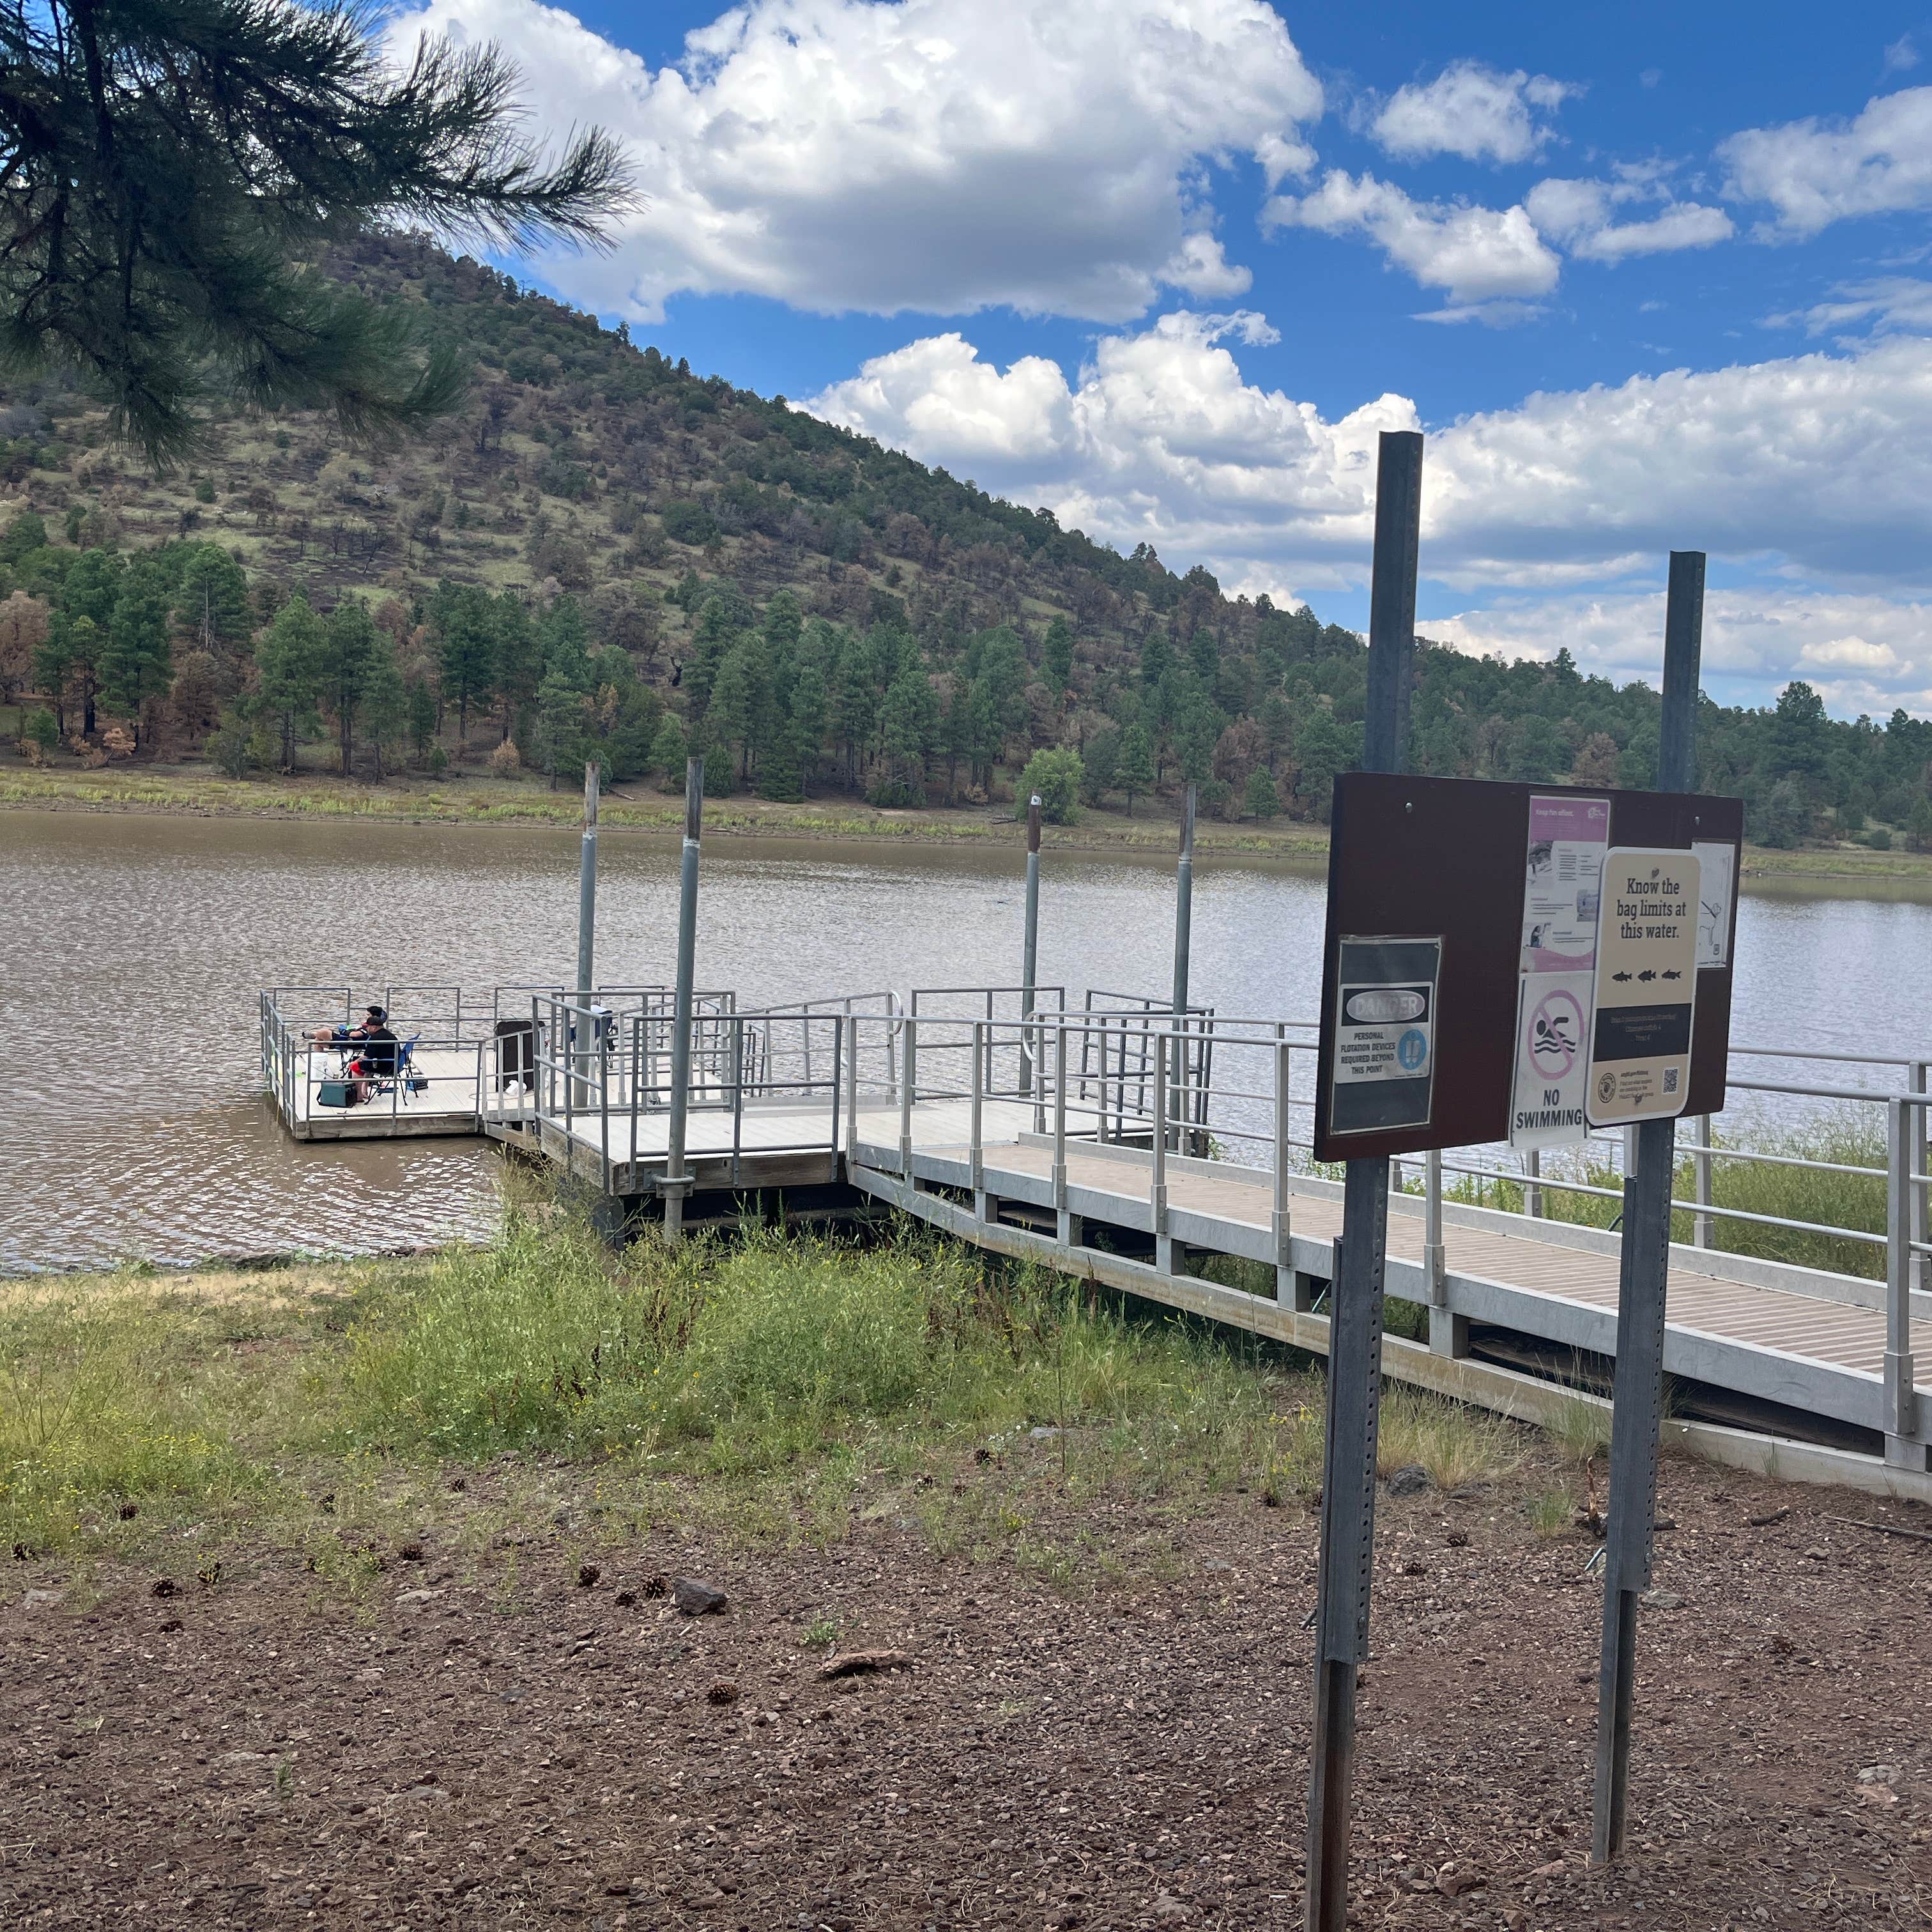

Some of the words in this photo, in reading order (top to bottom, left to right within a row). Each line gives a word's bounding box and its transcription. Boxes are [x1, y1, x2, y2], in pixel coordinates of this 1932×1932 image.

[1626, 878, 1659, 894] Know
[1662, 878, 1680, 894] the
[1616, 899, 1637, 921] bag
[1639, 899, 1673, 916] limits
[1675, 901, 1687, 916] at
[1621, 922, 1643, 939] this
[1646, 924, 1680, 939] water.
[1354, 1032, 1384, 1040] PERSONAL
[1341, 1043, 1370, 1053] FLOTATION
[1372, 1042, 1396, 1051] DEVICES
[1341, 1055, 1370, 1064] REQUIRED
[1371, 1054, 1395, 1062] BEYOND
[1365, 1065, 1383, 1073] POINT
[1543, 1089, 1560, 1106] NO
[1516, 1109, 1583, 1129] SWIMMING
